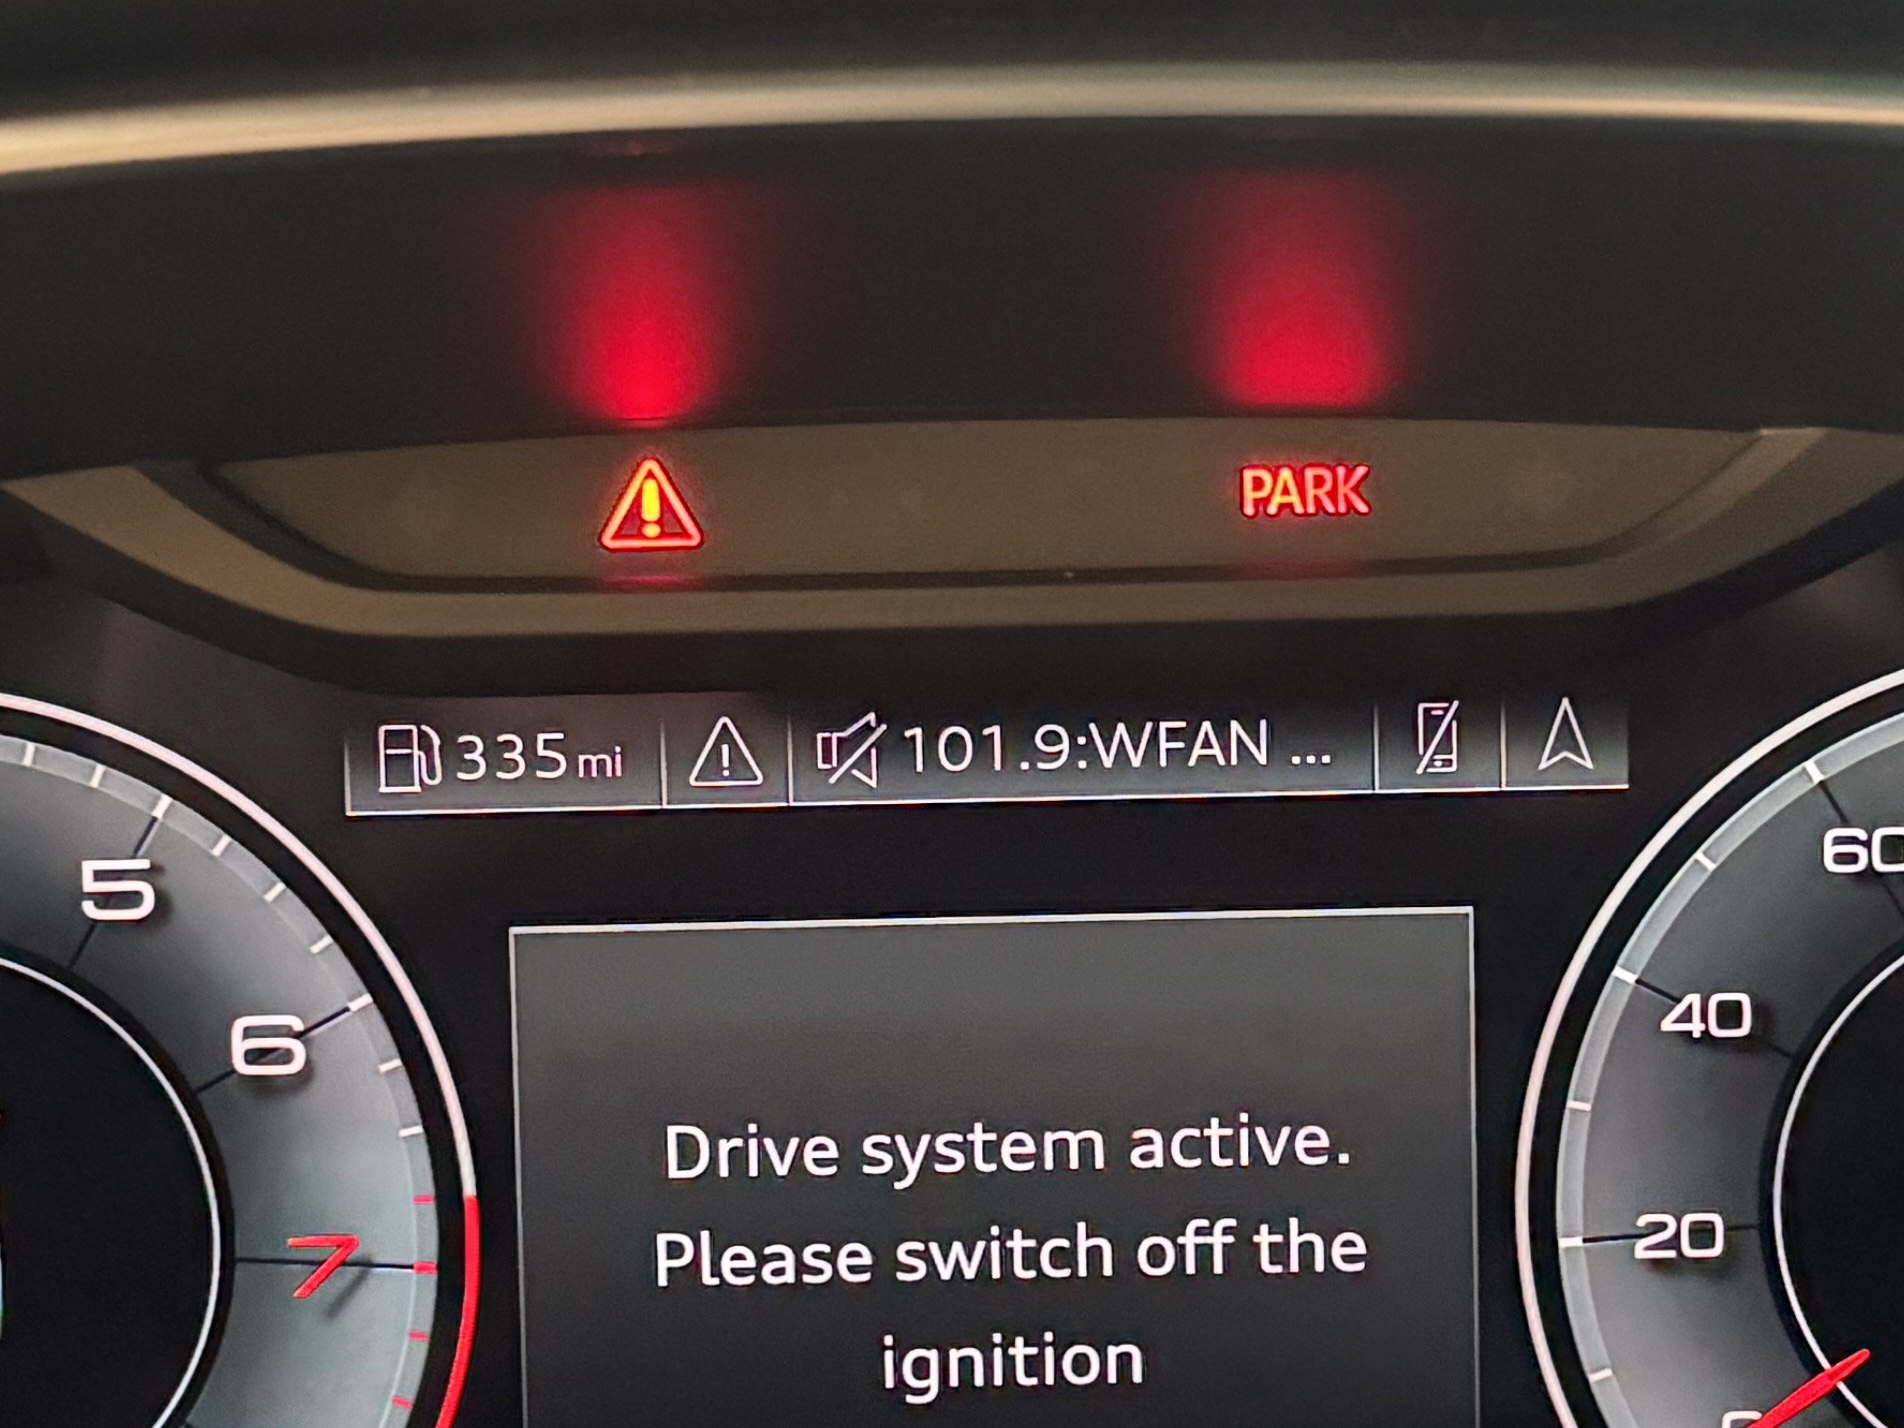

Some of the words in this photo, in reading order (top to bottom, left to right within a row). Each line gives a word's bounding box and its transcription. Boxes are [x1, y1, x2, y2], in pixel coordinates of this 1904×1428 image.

[1238, 460, 1373, 521] PARK
[903, 717, 1269, 774] 101.9:WFAN
[81, 858, 156, 921] 5
[230, 1013, 307, 1076] 6
[1659, 991, 1752, 1039] 40
[665, 1122, 840, 1180] Drive
[861, 1120, 1106, 1191] system
[1129, 1111, 1351, 1170] active.
[287, 1234, 361, 1300] 7
[655, 1228, 874, 1288] Please
[894, 1220, 1114, 1283] switch
[1136, 1216, 1239, 1277] off
[1251, 1215, 1368, 1275] the
[1633, 1212, 1725, 1260] 20
[882, 1330, 1144, 1406] ignition
